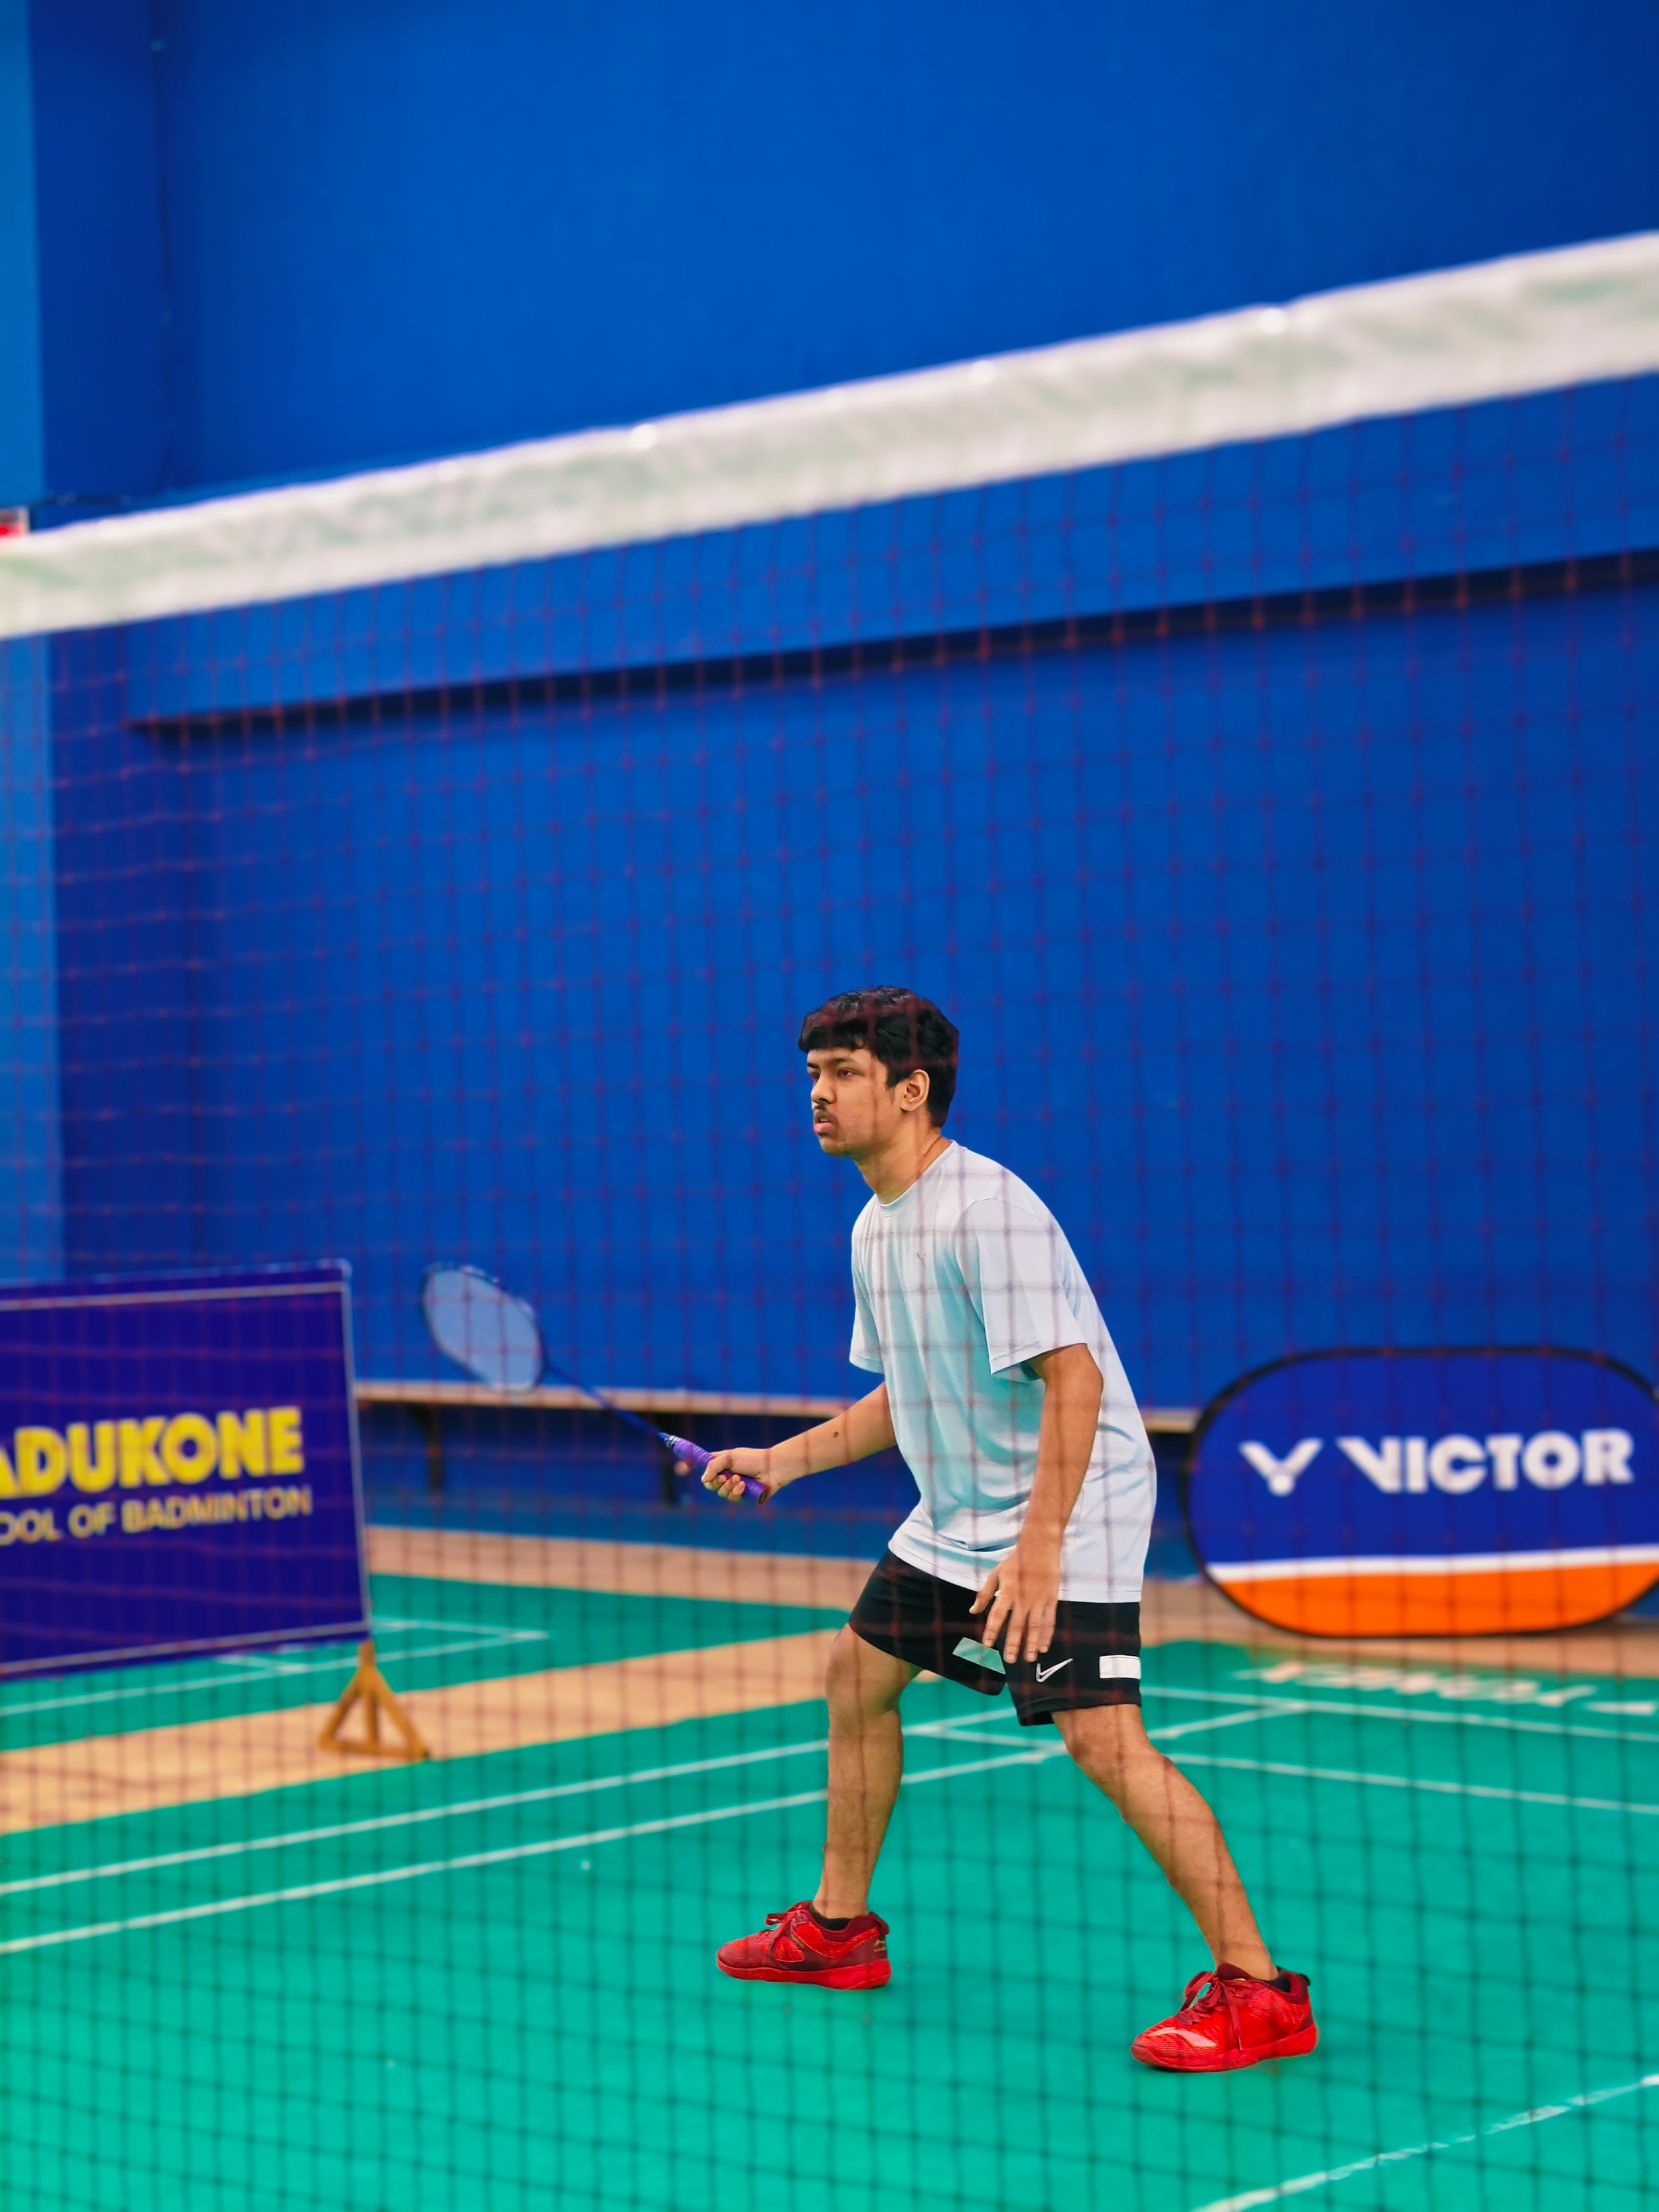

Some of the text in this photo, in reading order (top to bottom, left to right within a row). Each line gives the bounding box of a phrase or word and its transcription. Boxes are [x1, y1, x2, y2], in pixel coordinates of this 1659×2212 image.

[1337, 1428, 1634, 1494] VICTOR
[68, 1502, 114, 1539] OF
[121, 1485, 312, 1533] BADMINTON
